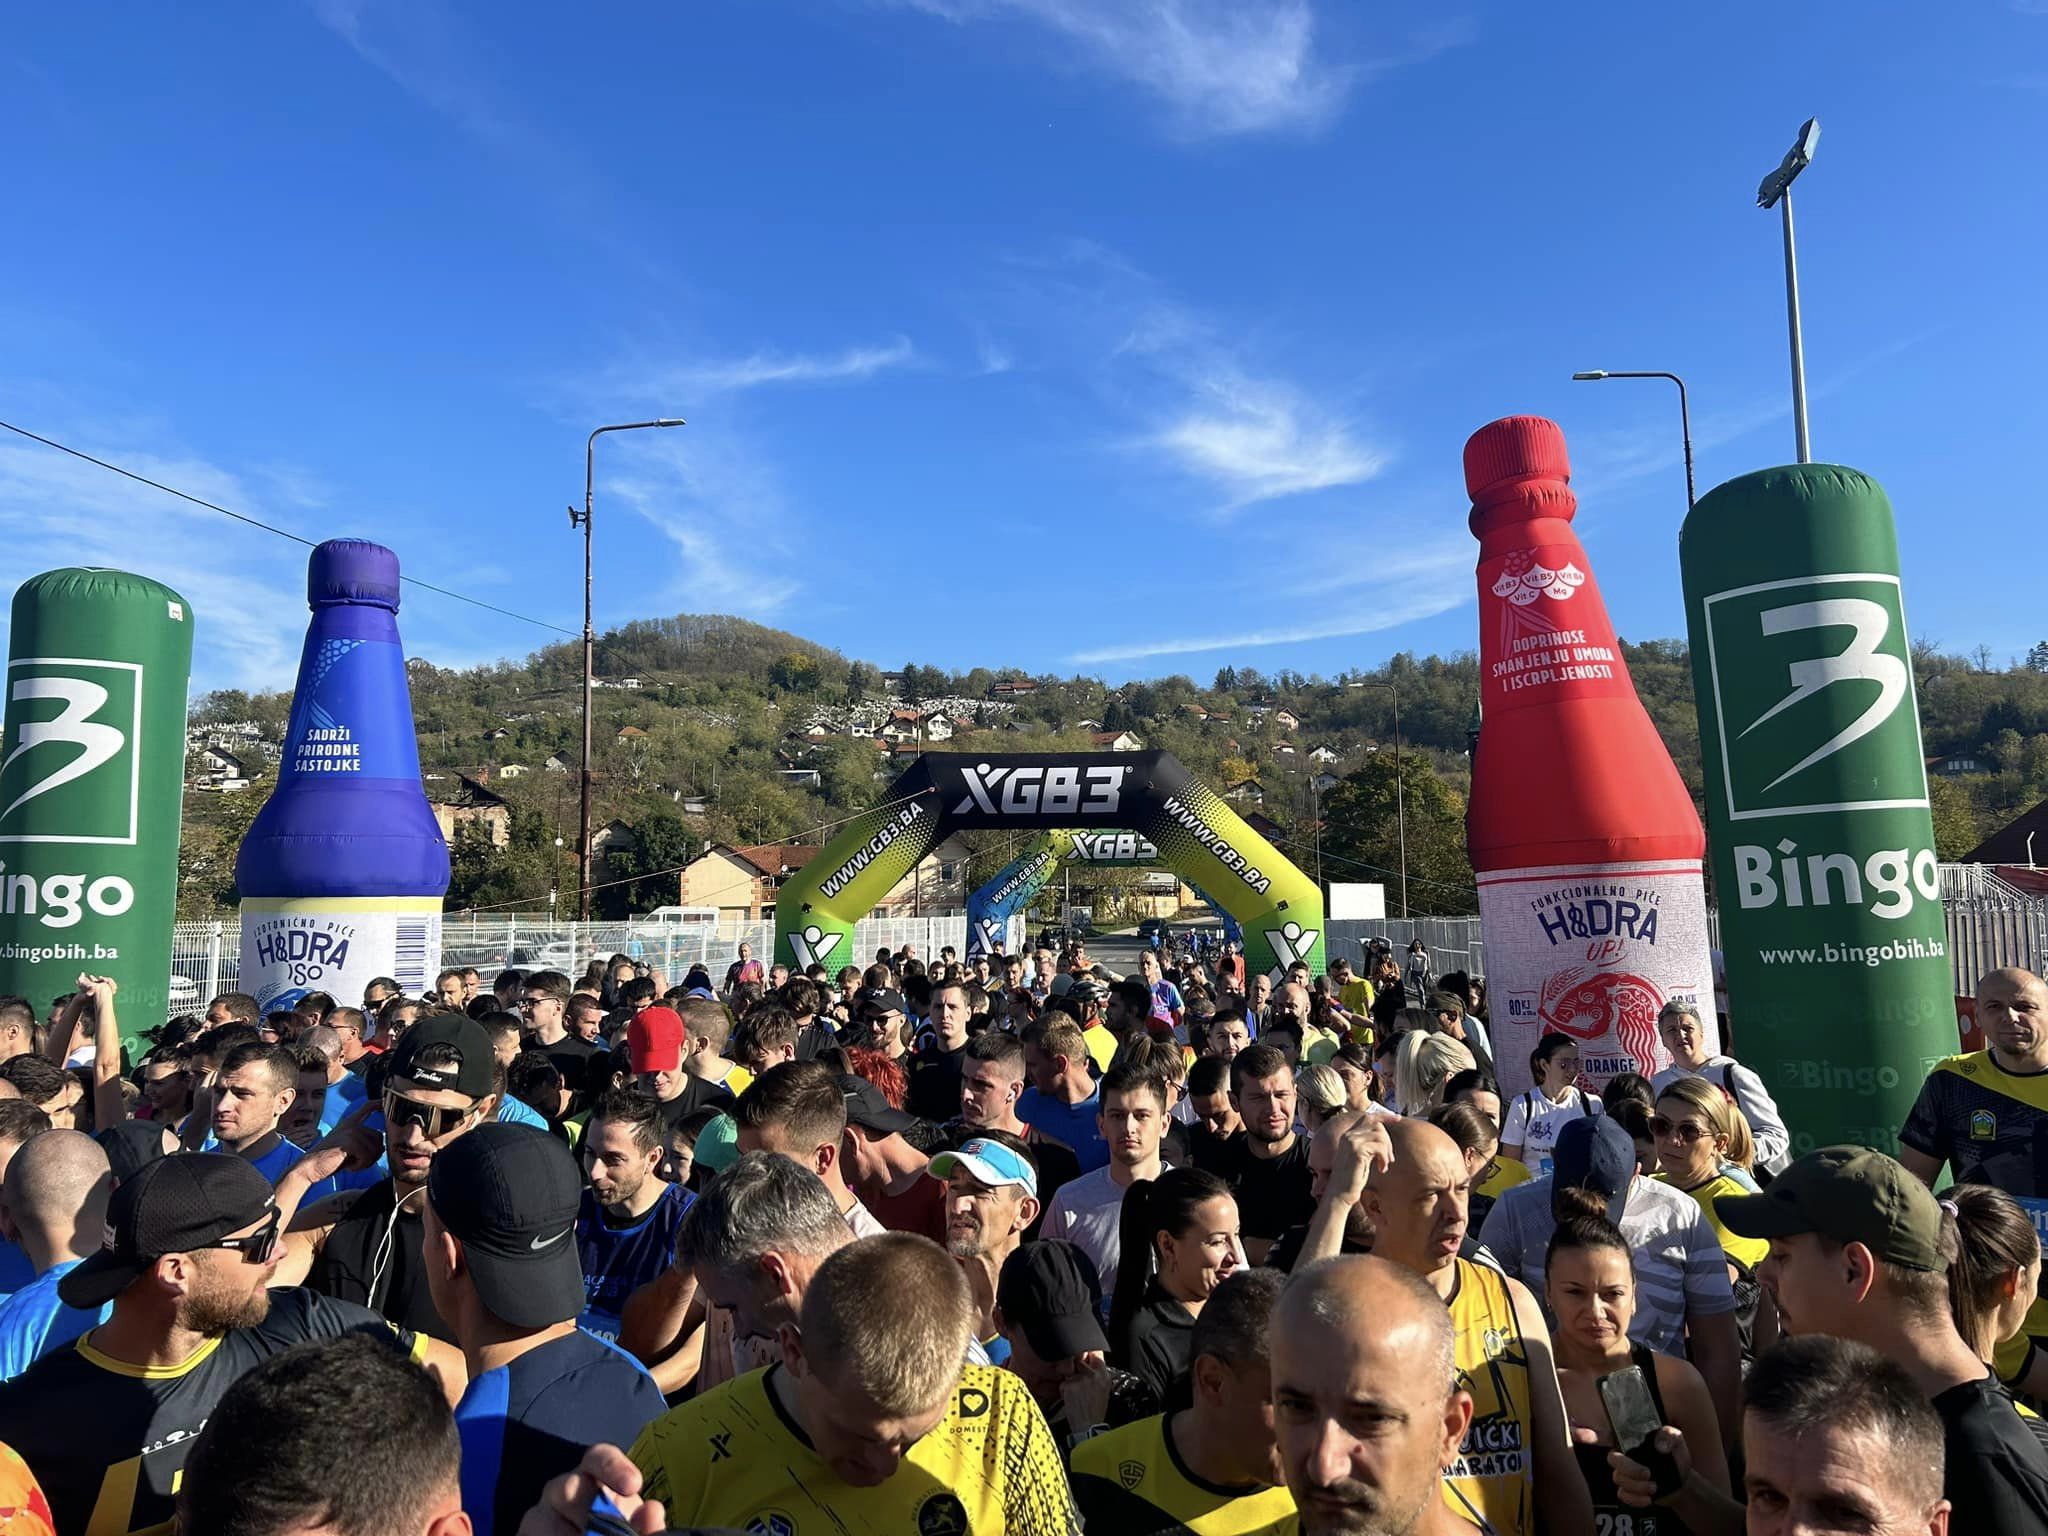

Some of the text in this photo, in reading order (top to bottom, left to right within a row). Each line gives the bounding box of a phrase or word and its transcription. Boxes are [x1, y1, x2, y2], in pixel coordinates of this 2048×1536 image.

[1524, 572, 1553, 583] Vit B5
[1513, 590, 1536, 602] Vit C
[1512, 629, 1587, 653] DOPRINOSE
[1492, 646, 1615, 678] SMANJENJU UMORA
[1502, 664, 1613, 693] I ISCRPLJENOSTI
[307, 726, 350, 741] SADRŽI
[297, 742, 360, 757] PRIRODNE
[294, 757, 361, 772] SASTOJKE
[820, 801, 923, 898] WWW.GB3.BA
[1162, 796, 1272, 895] WWW.GB3.BA
[991, 851, 1050, 904] WWW.GB3.BA
[1733, 838, 1940, 920] Bingo
[1530, 885, 1626, 912] FUNKCIONALNO
[1586, 938, 1625, 962] UP!
[1760, 938, 1945, 967] www.bingobih.ba
[1508, 999, 1521, 1016] 80
[1585, 1058, 1634, 1073] ORANGE
[1801, 1057, 1900, 1096] Bingo
